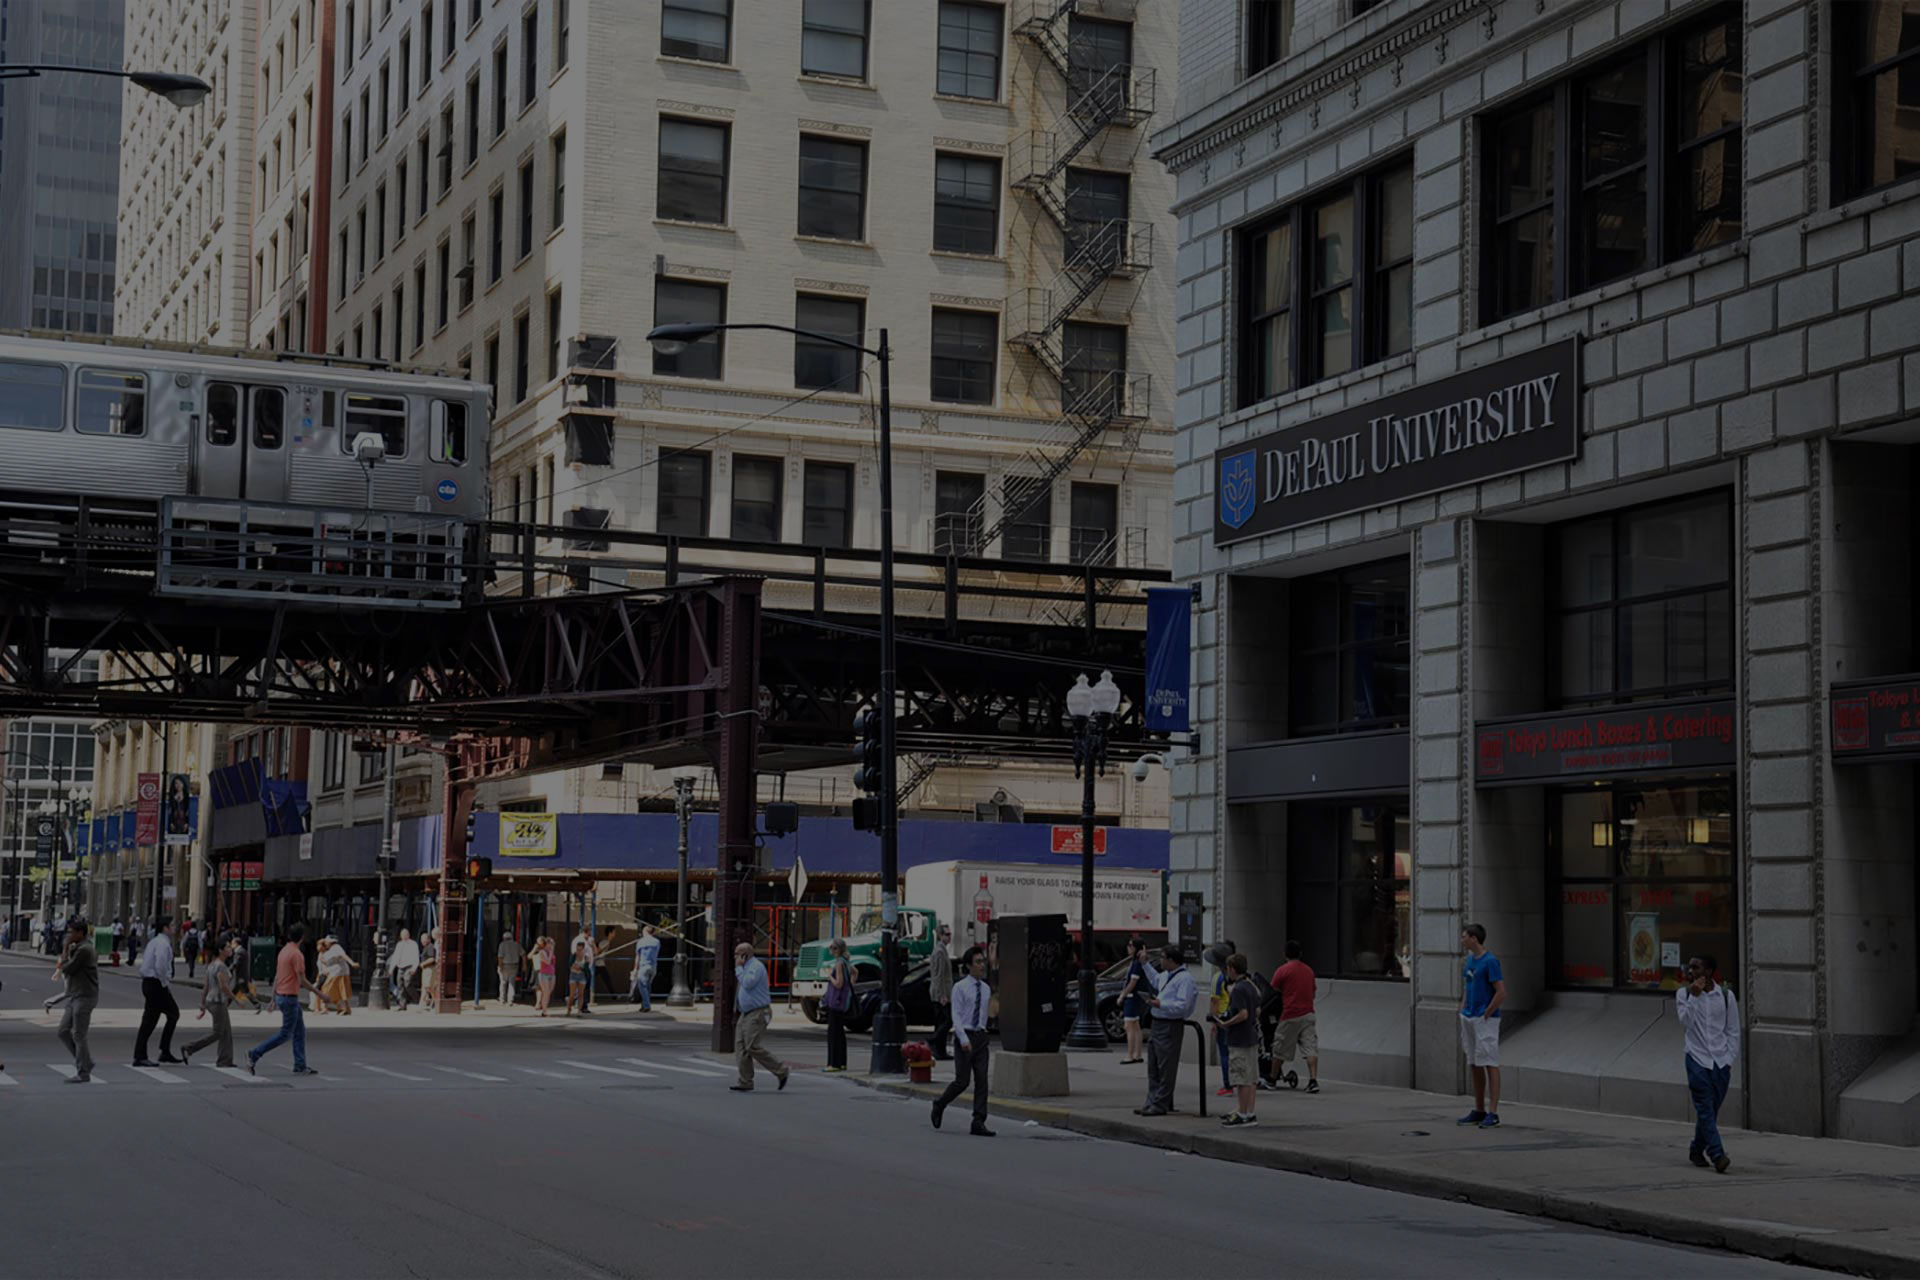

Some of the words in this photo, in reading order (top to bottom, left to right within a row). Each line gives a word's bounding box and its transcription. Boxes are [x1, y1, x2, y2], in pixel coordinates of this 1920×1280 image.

[1368, 372, 1560, 474] UNIVERSITY
[1868, 688, 1909, 711] Tokyo
[1507, 729, 1547, 758] Tokyo
[1551, 720, 1592, 750] Lunch
[1597, 719, 1641, 746] Boxes
[1648, 714, 1658, 741] &
[1663, 707, 1733, 744] Catering
[995, 876, 1015, 885] RAISE
[1017, 877, 1035, 886] YOUR
[1037, 878, 1059, 887] GLASS
[1060, 878, 1070, 887] TO
[1104, 881, 1123, 890] YORK
[1560, 890, 1608, 905] EXPRESS
